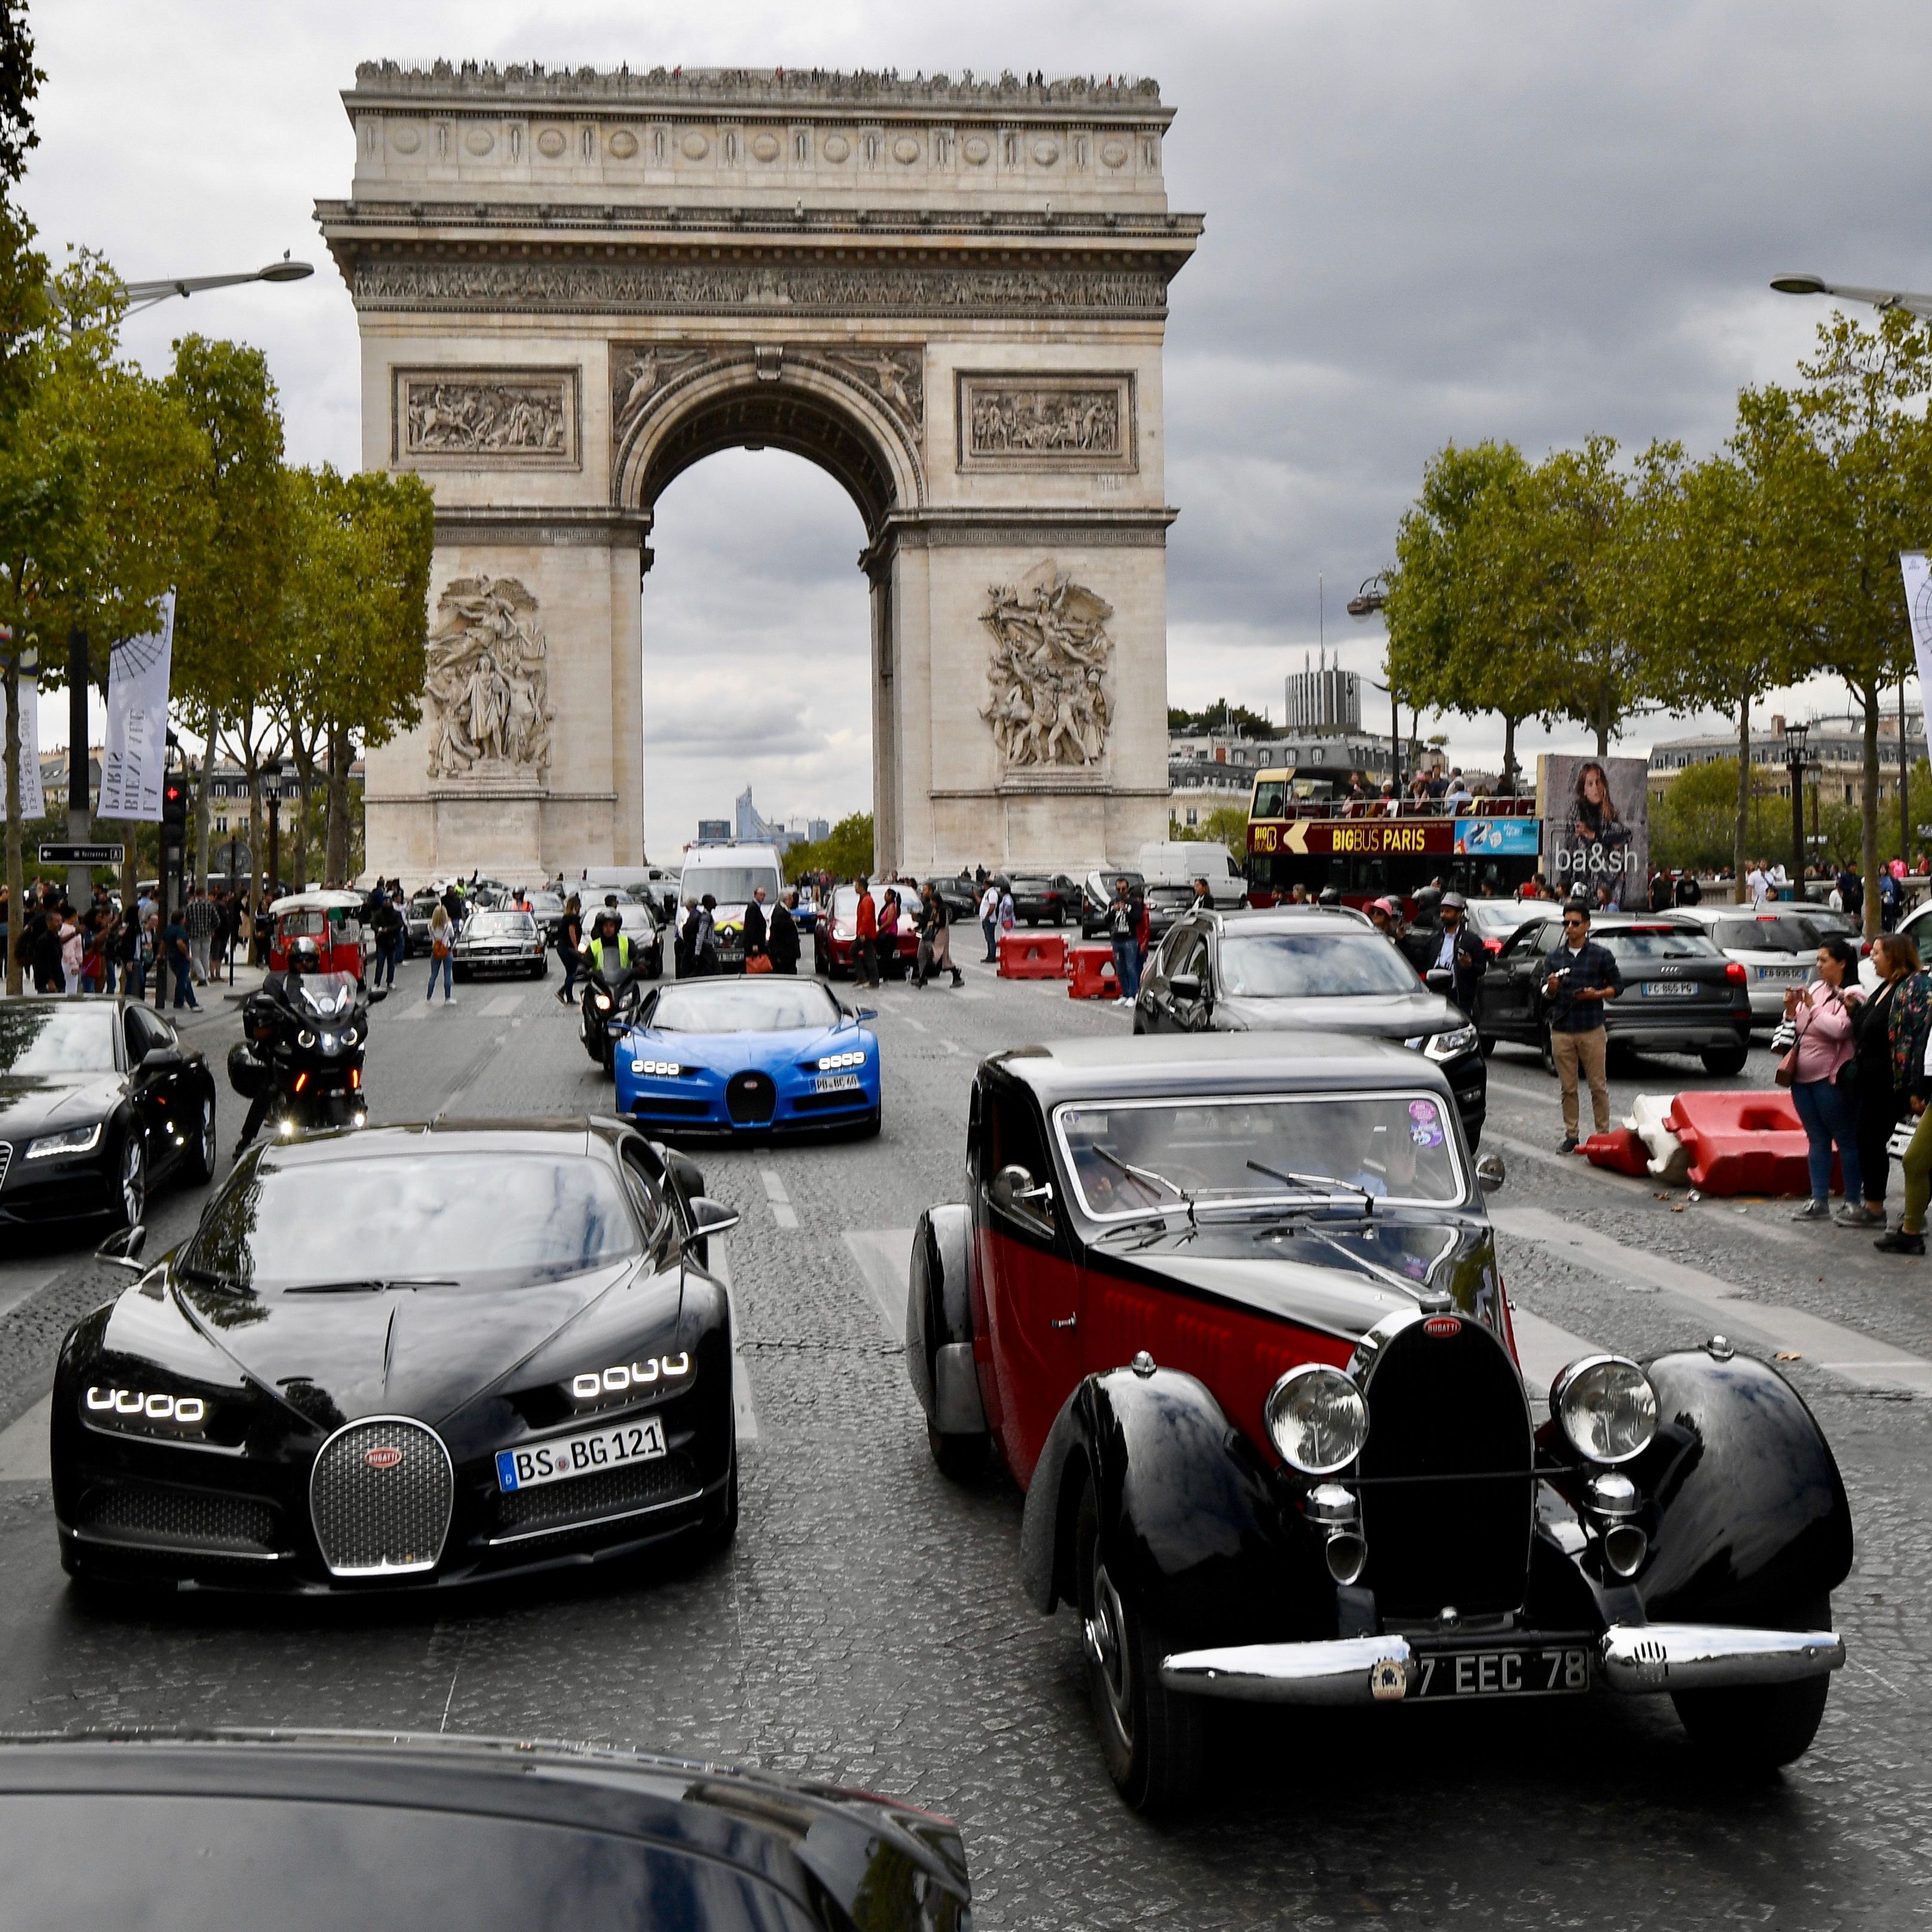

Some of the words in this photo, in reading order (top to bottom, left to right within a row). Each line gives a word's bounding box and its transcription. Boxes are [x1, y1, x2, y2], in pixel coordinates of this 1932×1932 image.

[1383, 829, 1425, 851] PARIS
[1555, 841, 1638, 873] ba&sh
[1427, 1323, 1457, 1333] BUGATTI
[369, 1453, 398, 1463] BUGATTI
[516, 1449, 554, 1481] BS
[570, 1437, 610, 1469] BG
[613, 1425, 661, 1459] 121
[1455, 1653, 1522, 1693] EEC
[1542, 1650, 1587, 1689] 78
